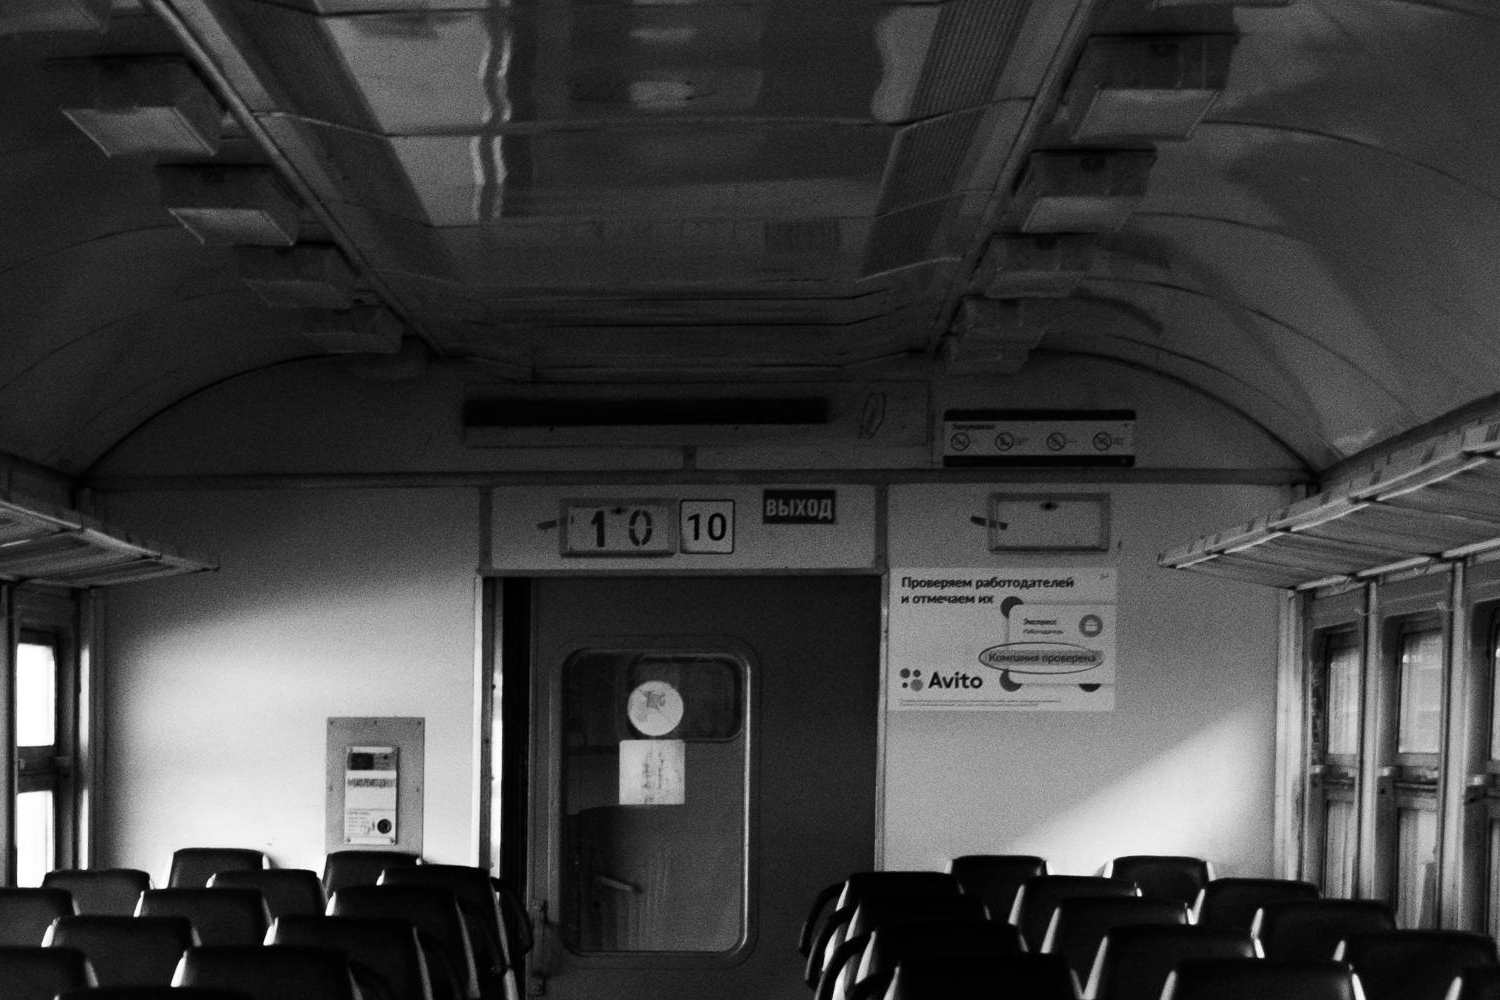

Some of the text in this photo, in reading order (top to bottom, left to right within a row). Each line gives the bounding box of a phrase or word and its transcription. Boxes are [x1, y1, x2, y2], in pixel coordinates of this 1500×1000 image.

[765, 498, 833, 520] ВЫХОД
[590, 509, 653, 548] 10
[686, 512, 728, 542] 10
[901, 576, 1075, 590] Проверяем работодателей
[901, 595, 995, 604] и отмечаем их
[988, 653, 1097, 664] Компания проверена
[927, 672, 983, 689] Avito
